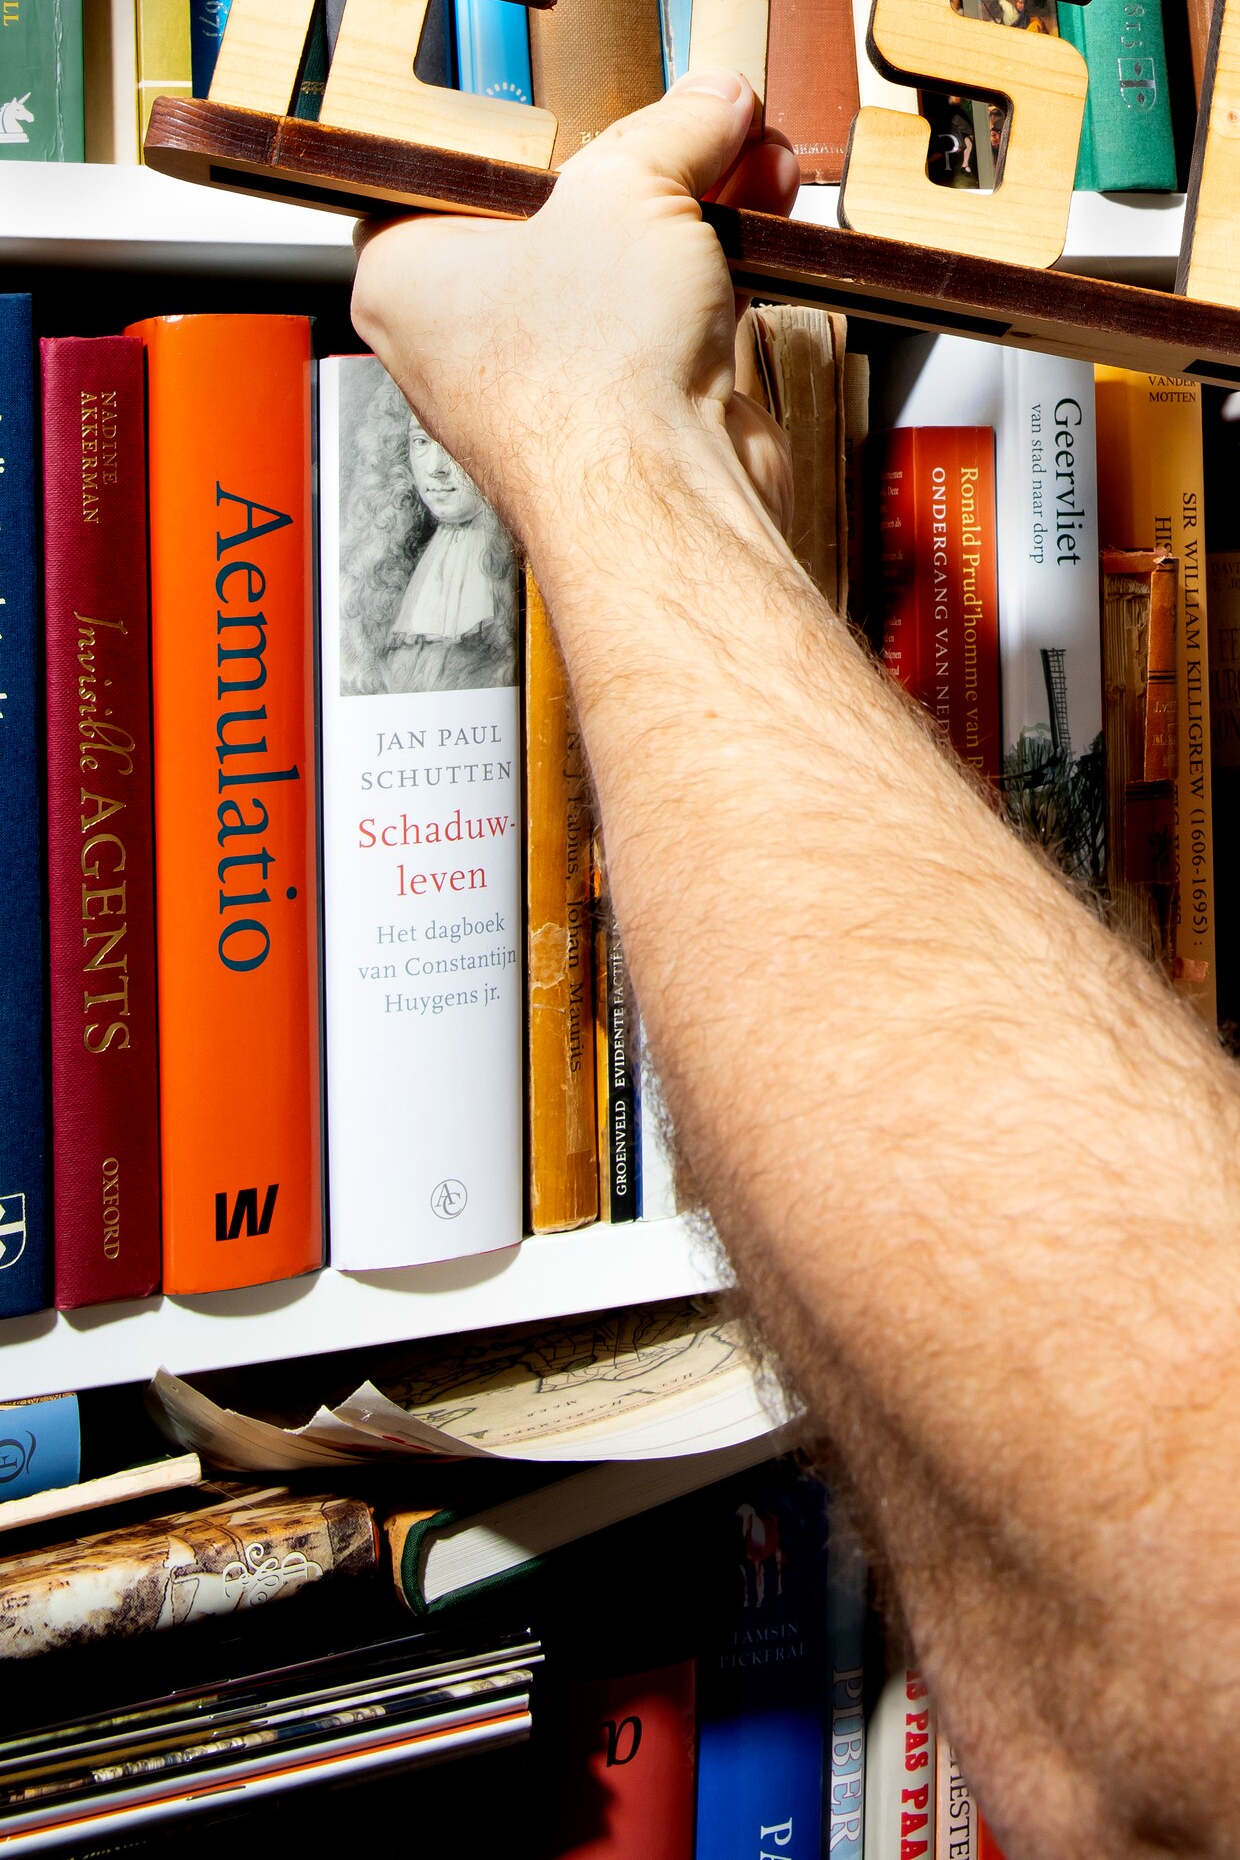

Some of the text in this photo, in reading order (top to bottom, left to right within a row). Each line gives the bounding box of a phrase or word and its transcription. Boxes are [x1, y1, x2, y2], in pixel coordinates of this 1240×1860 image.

[102, 390, 118, 485] NADINE
[1149, 391, 1197, 403] MOTTEN
[80, 390, 99, 525] AKKERMAN
[1029, 404, 1047, 565] van stad naar dorp
[1053, 396, 1086, 567] Geervliet
[959, 466, 982, 547] Ronald
[1182, 492, 1198, 530] SIR
[931, 466, 950, 677] ONDERGANG VAN
[1184, 542, 1202, 651] WILLIAM
[962, 552, 984, 702] Prud'homme
[214, 480, 300, 973] Aemulatio
[376, 725, 503, 757] JAN PAUL
[966, 707, 981, 749] van
[1185, 659, 1206, 801] KILLIGREW
[361, 761, 513, 791] SCHUTTEN
[73, 610, 136, 1054] Invisible AGENTS
[358, 809, 518, 850] Schaduw-
[395, 863, 489, 898] leven
[358, 945, 518, 981] van Constantijn
[376, 912, 506, 950] Het dagboek
[384, 982, 502, 1018] Huygens jr.
[566, 898, 586, 1073] Johan Maurits
[612, 1008, 629, 1197] GROENVELD EVIDENTE
[101, 1156, 120, 1261] OXFORD
[730, 1620, 800, 1646] TAMSIN
[904, 1708, 930, 1772] PAS
